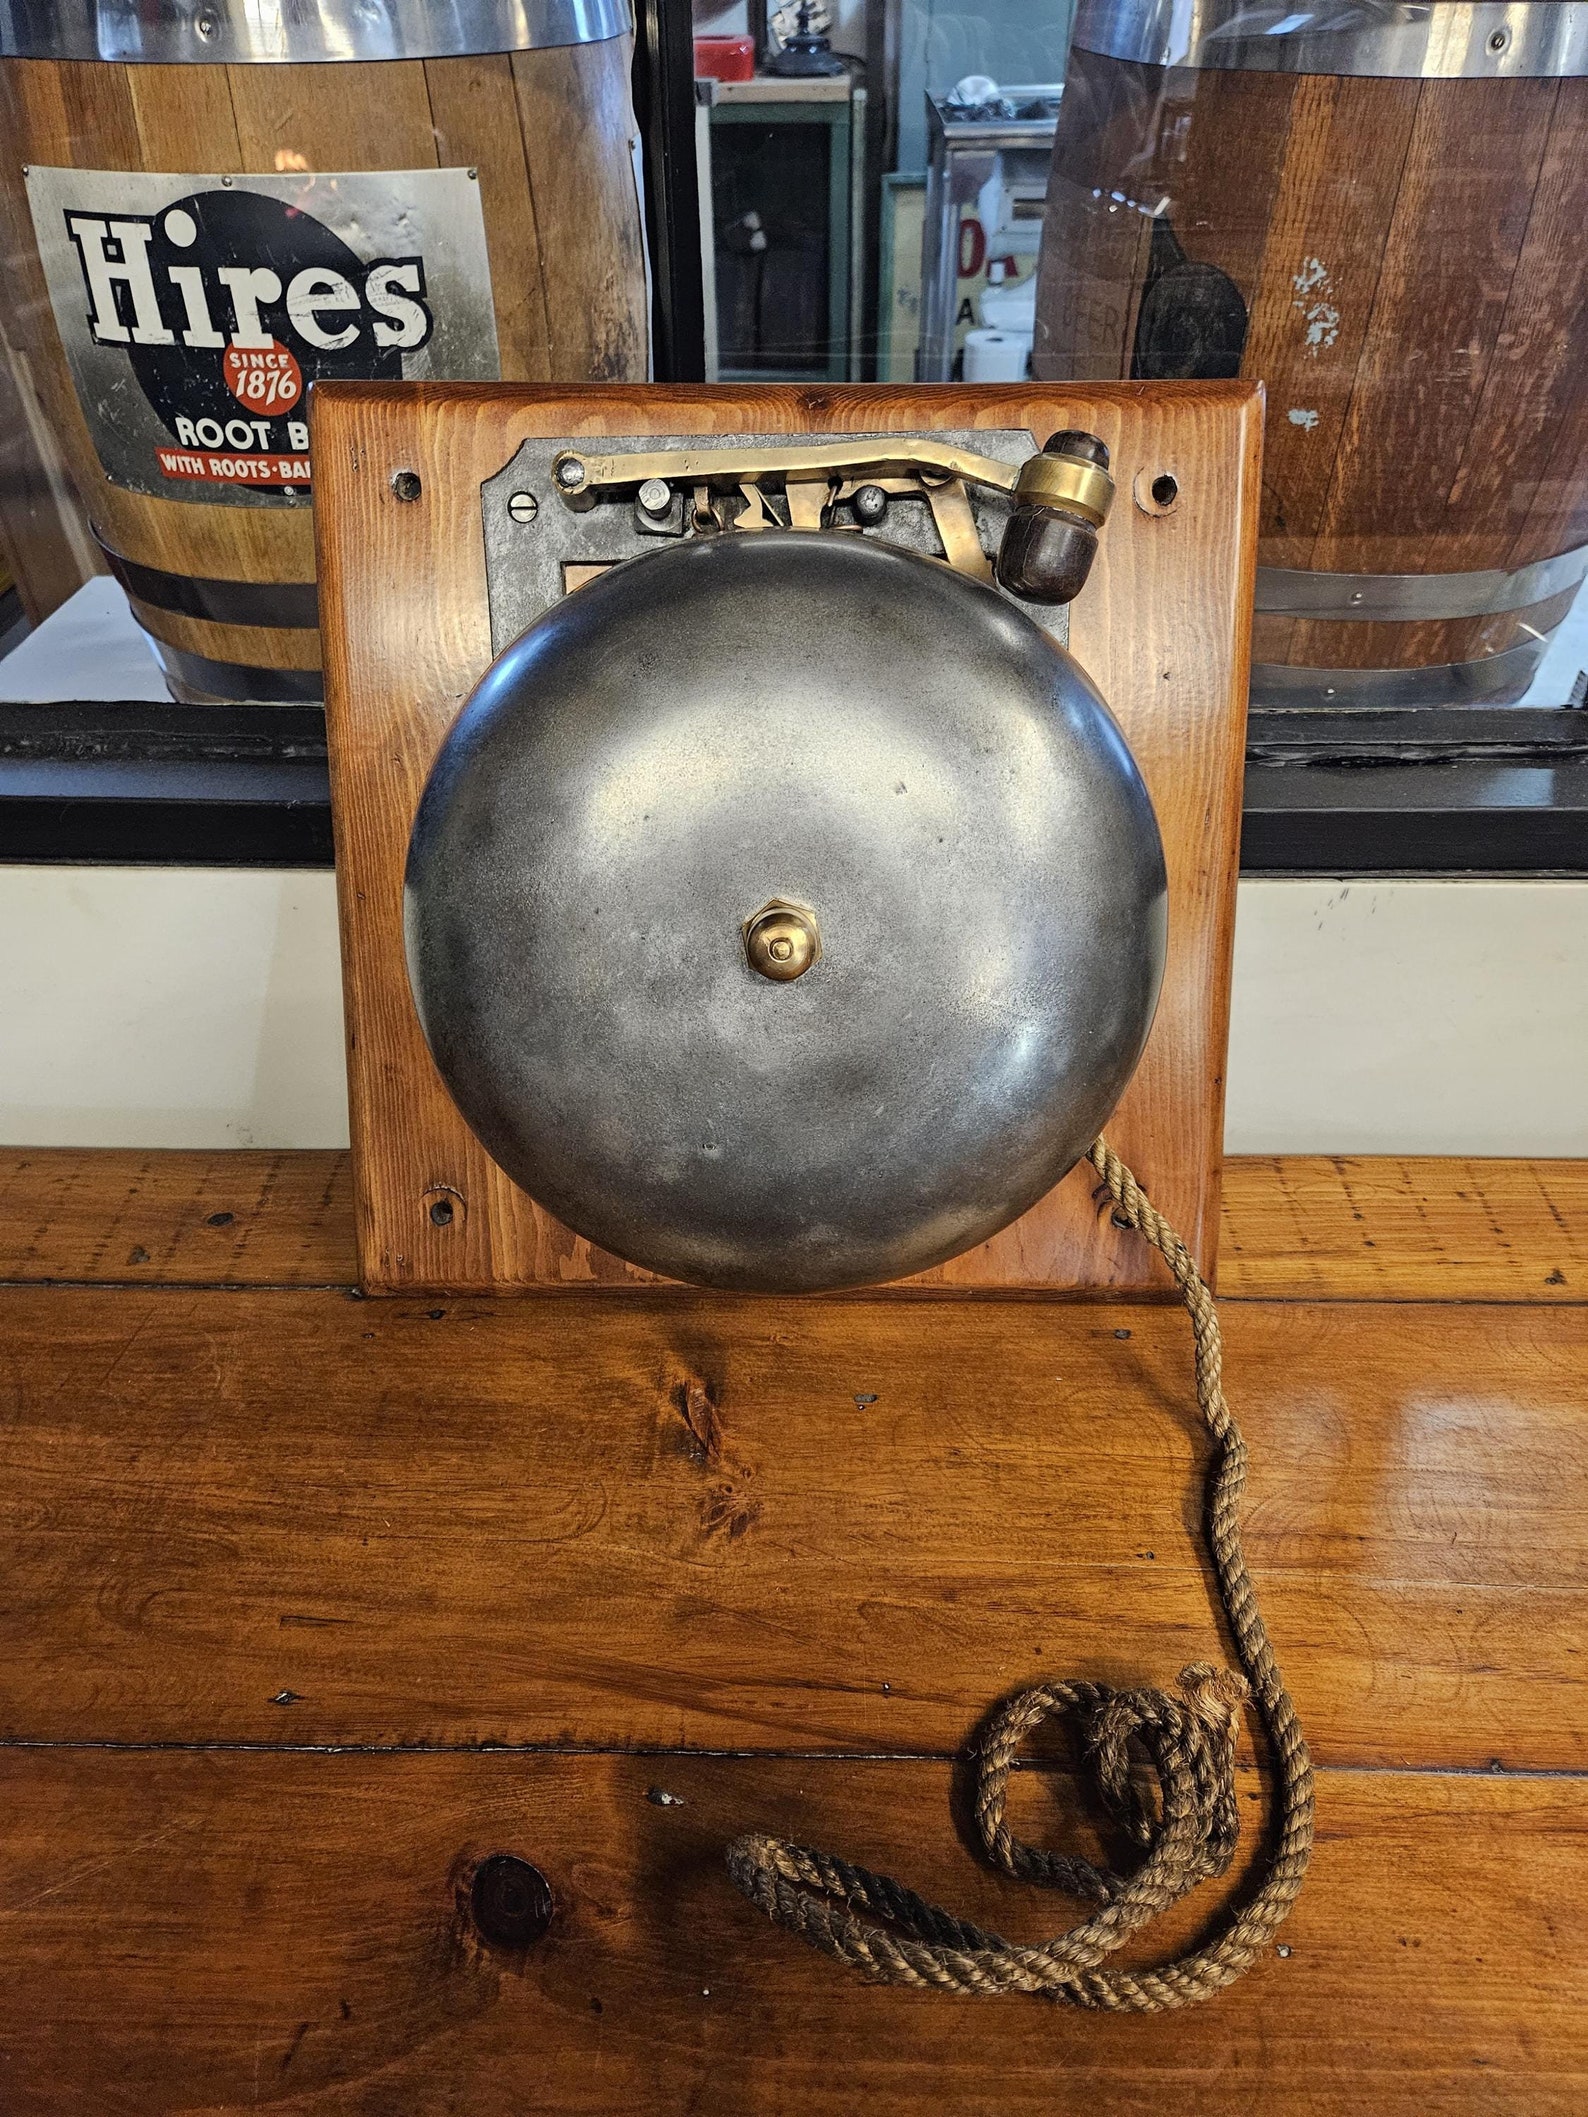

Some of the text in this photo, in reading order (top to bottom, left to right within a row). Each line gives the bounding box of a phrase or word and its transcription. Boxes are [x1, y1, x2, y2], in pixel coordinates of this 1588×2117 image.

[69, 208, 429, 350] Hires
[229, 352, 289, 369] SINCE
[235, 369, 297, 406] 1876
[175, 417, 271, 450] ROOT
[160, 453, 205, 475] WITH
